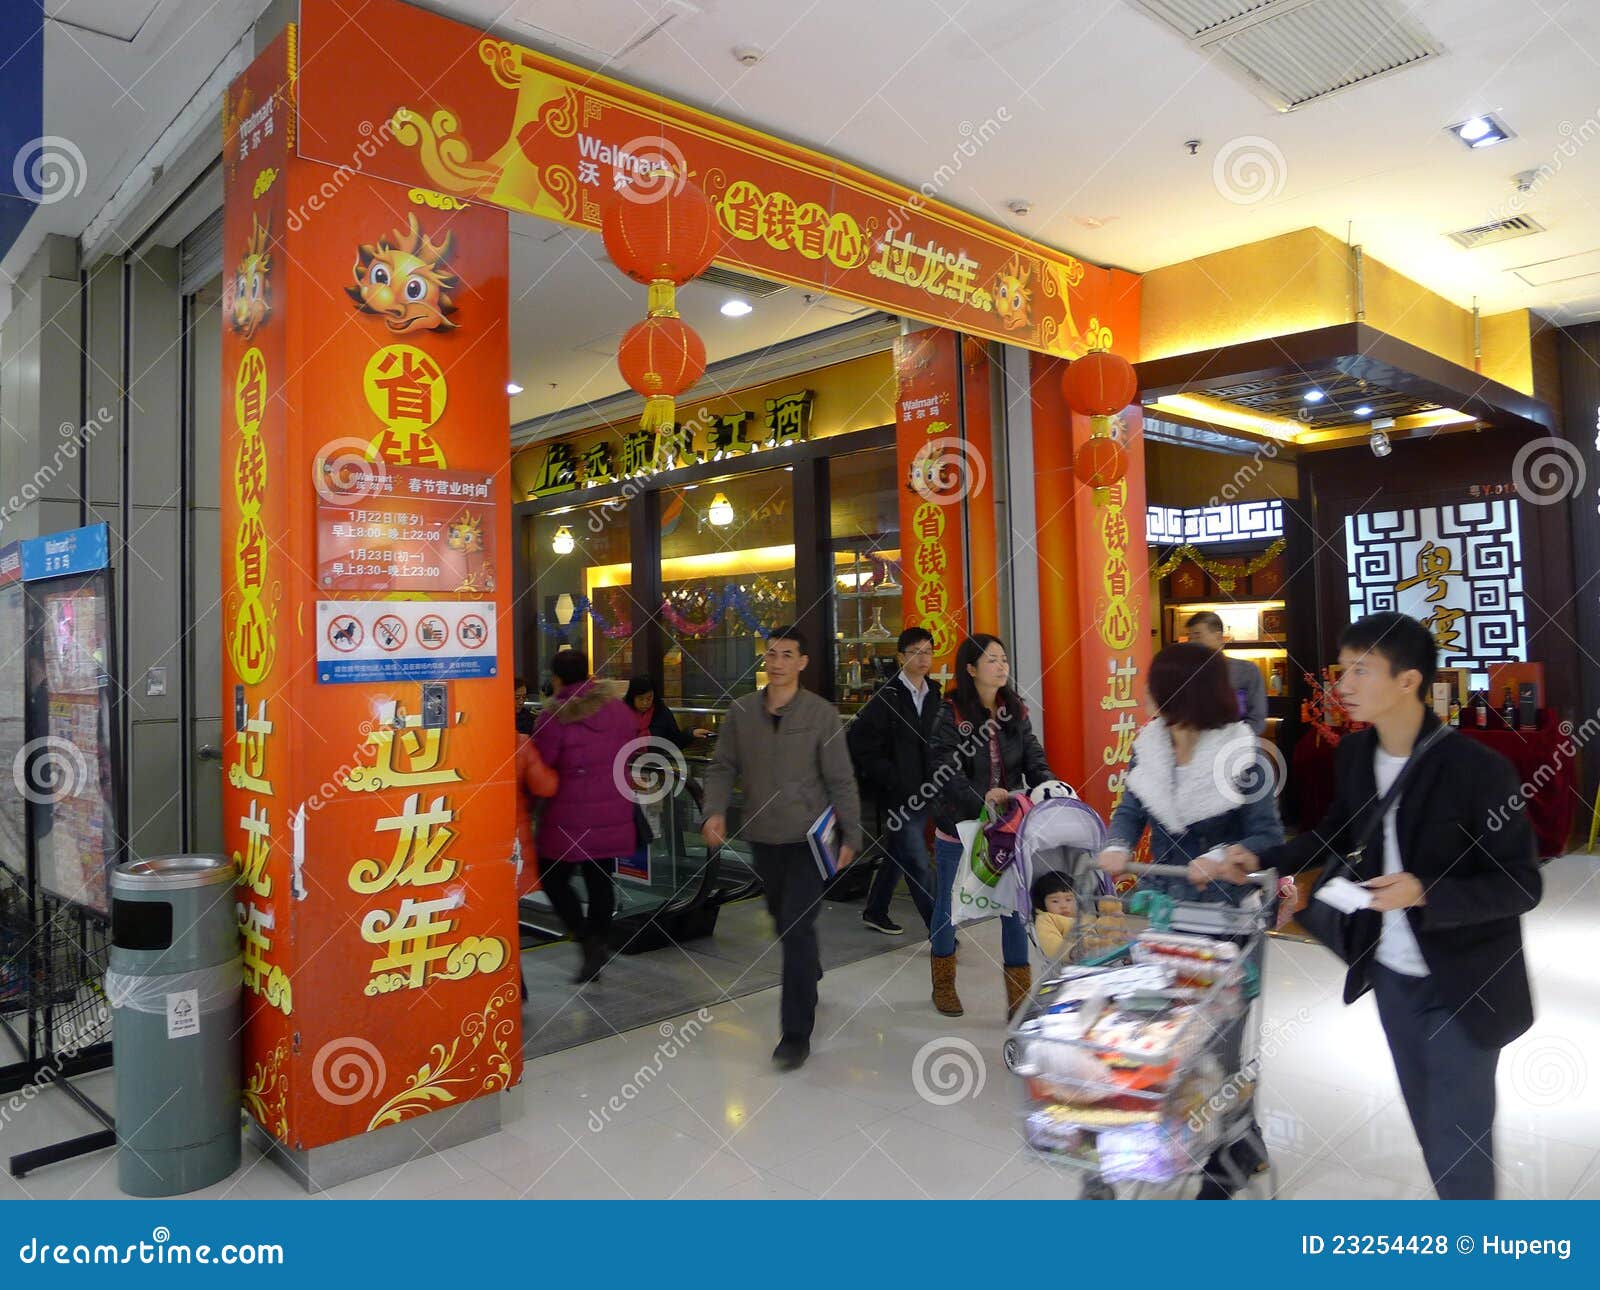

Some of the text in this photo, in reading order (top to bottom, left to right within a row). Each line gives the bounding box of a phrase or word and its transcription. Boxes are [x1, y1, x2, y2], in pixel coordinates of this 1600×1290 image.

[240, 95, 273, 139] Walmart
[731, 185, 986, 307] 省钱省心 过龙年
[902, 395, 939, 411] Walmart
[408, 478, 488, 497] 春节营业时间
[229, 353, 285, 1005] 省钱省心 过龙年
[343, 700, 480, 994] 过龙年
